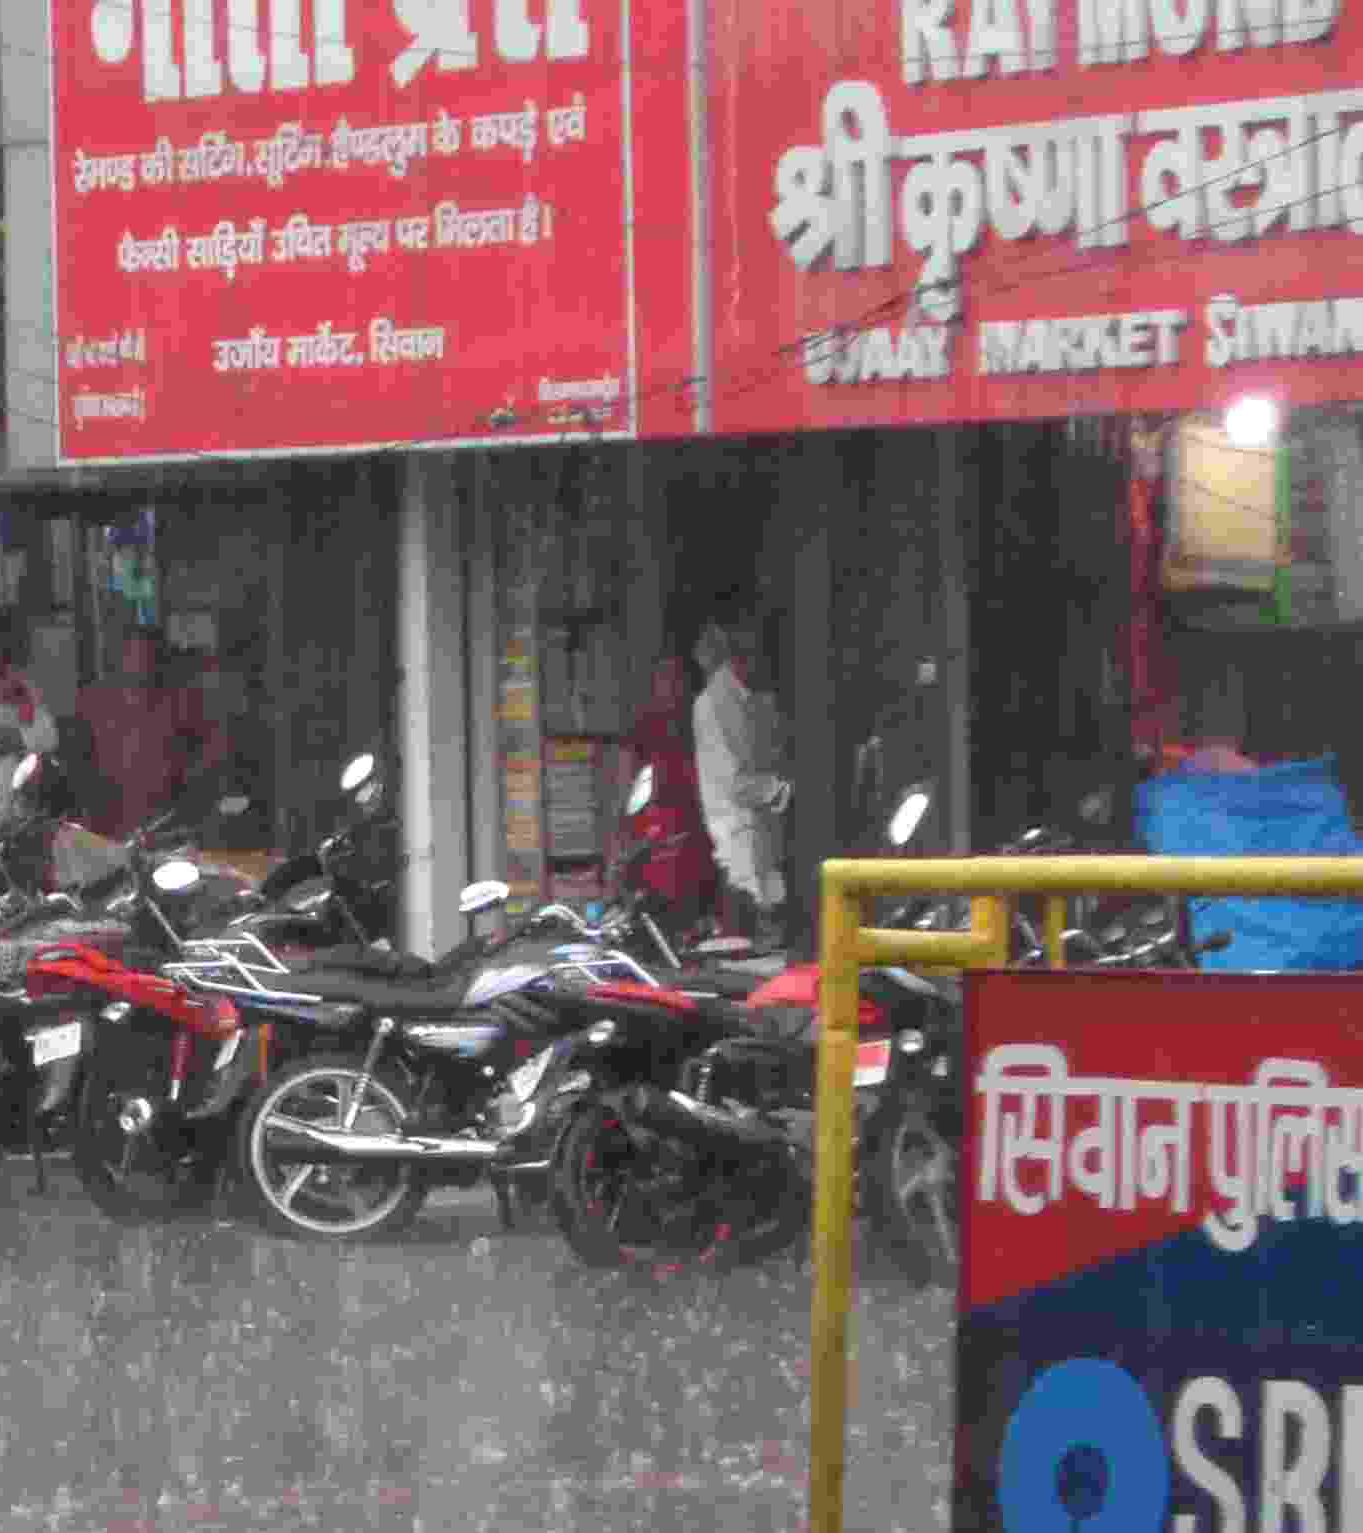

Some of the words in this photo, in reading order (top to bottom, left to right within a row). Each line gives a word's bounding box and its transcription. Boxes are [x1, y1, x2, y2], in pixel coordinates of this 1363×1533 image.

[140, 136, 173, 184] की
[433, 108, 462, 155] के
[471, 98, 538, 163] कपड़े
[548, 91, 587, 145] एवं
[271, 212, 333, 264] उचित
[337, 217, 389, 273] मूल्य
[395, 216, 430, 250] पर
[369, 317, 446, 364] सिवान
[978, 309, 1187, 375] MARKET
[974, 1044, 1195, 1216] सिवान
